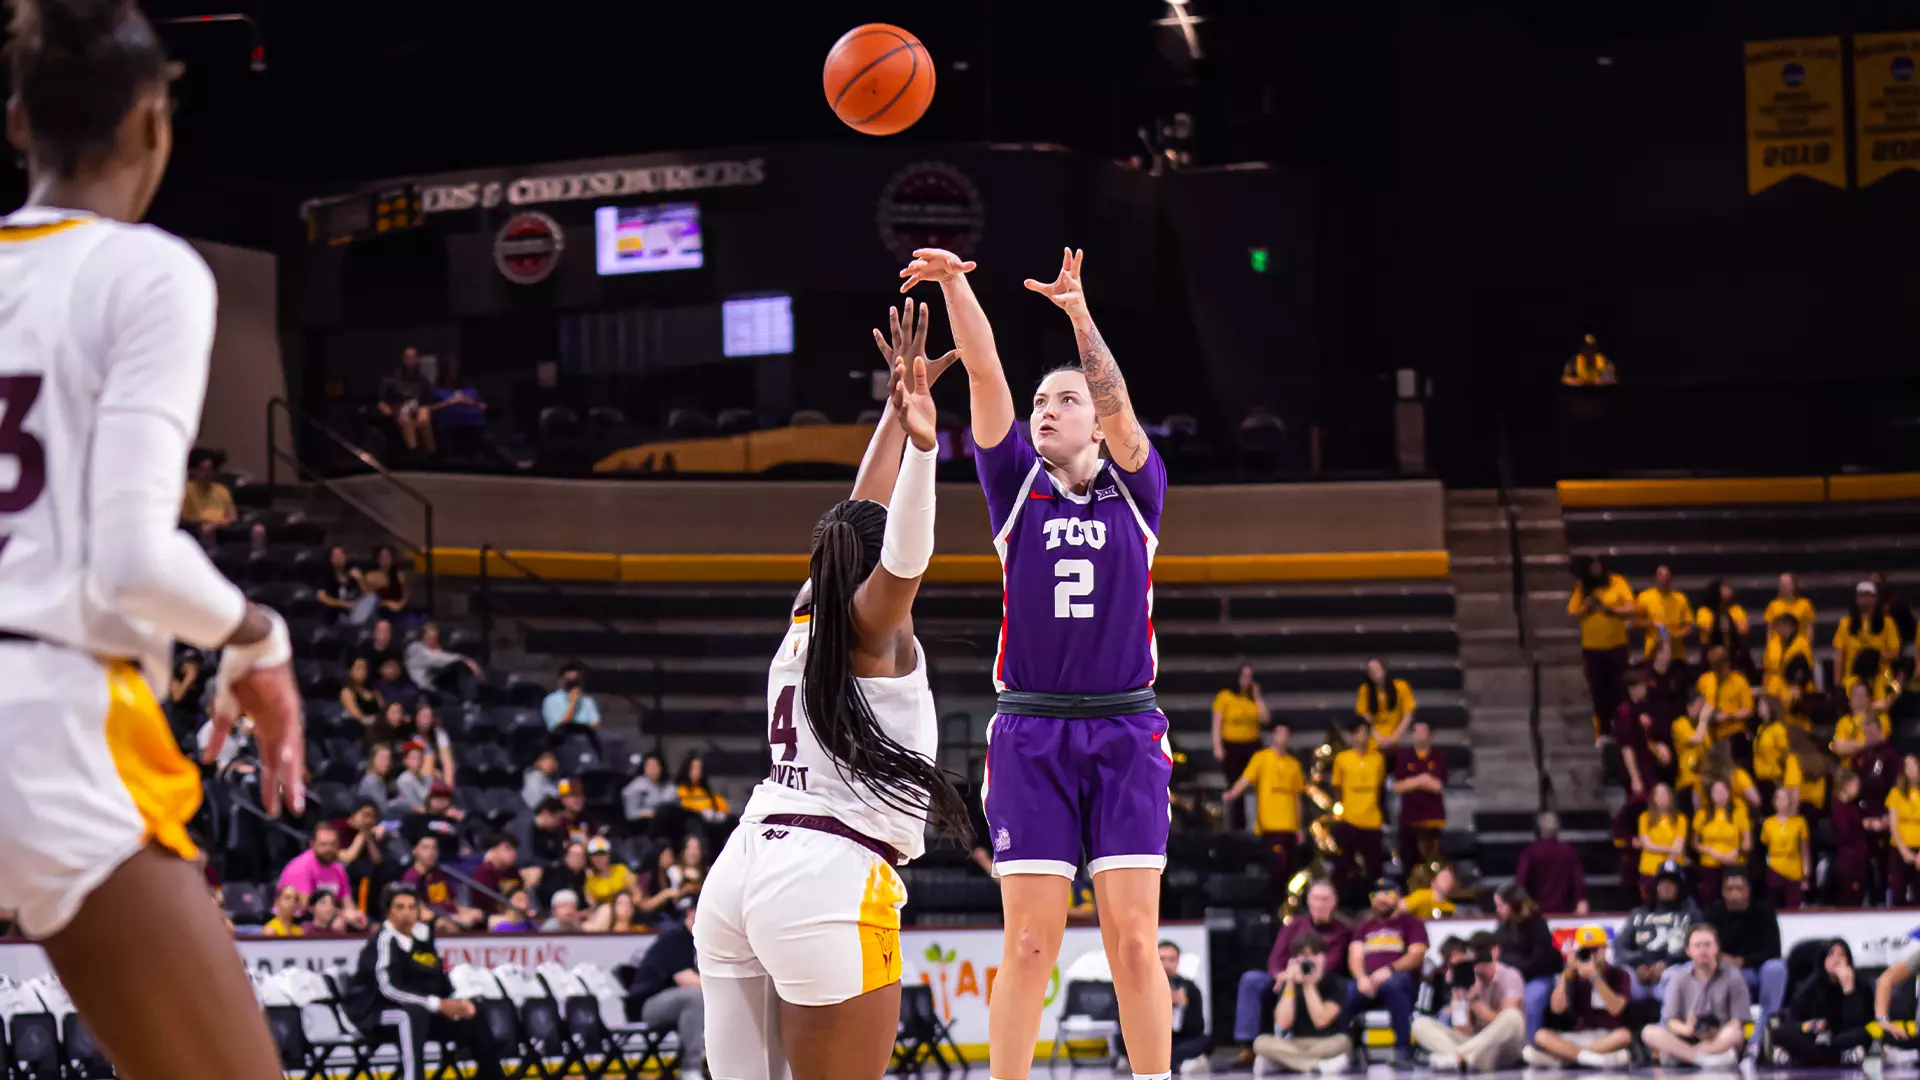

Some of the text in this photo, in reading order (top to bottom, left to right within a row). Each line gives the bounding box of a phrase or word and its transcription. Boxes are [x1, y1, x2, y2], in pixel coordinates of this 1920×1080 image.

[1043, 517, 1107, 550] TCU
[1055, 559, 1094, 618] 2
[770, 686, 797, 761] 4
